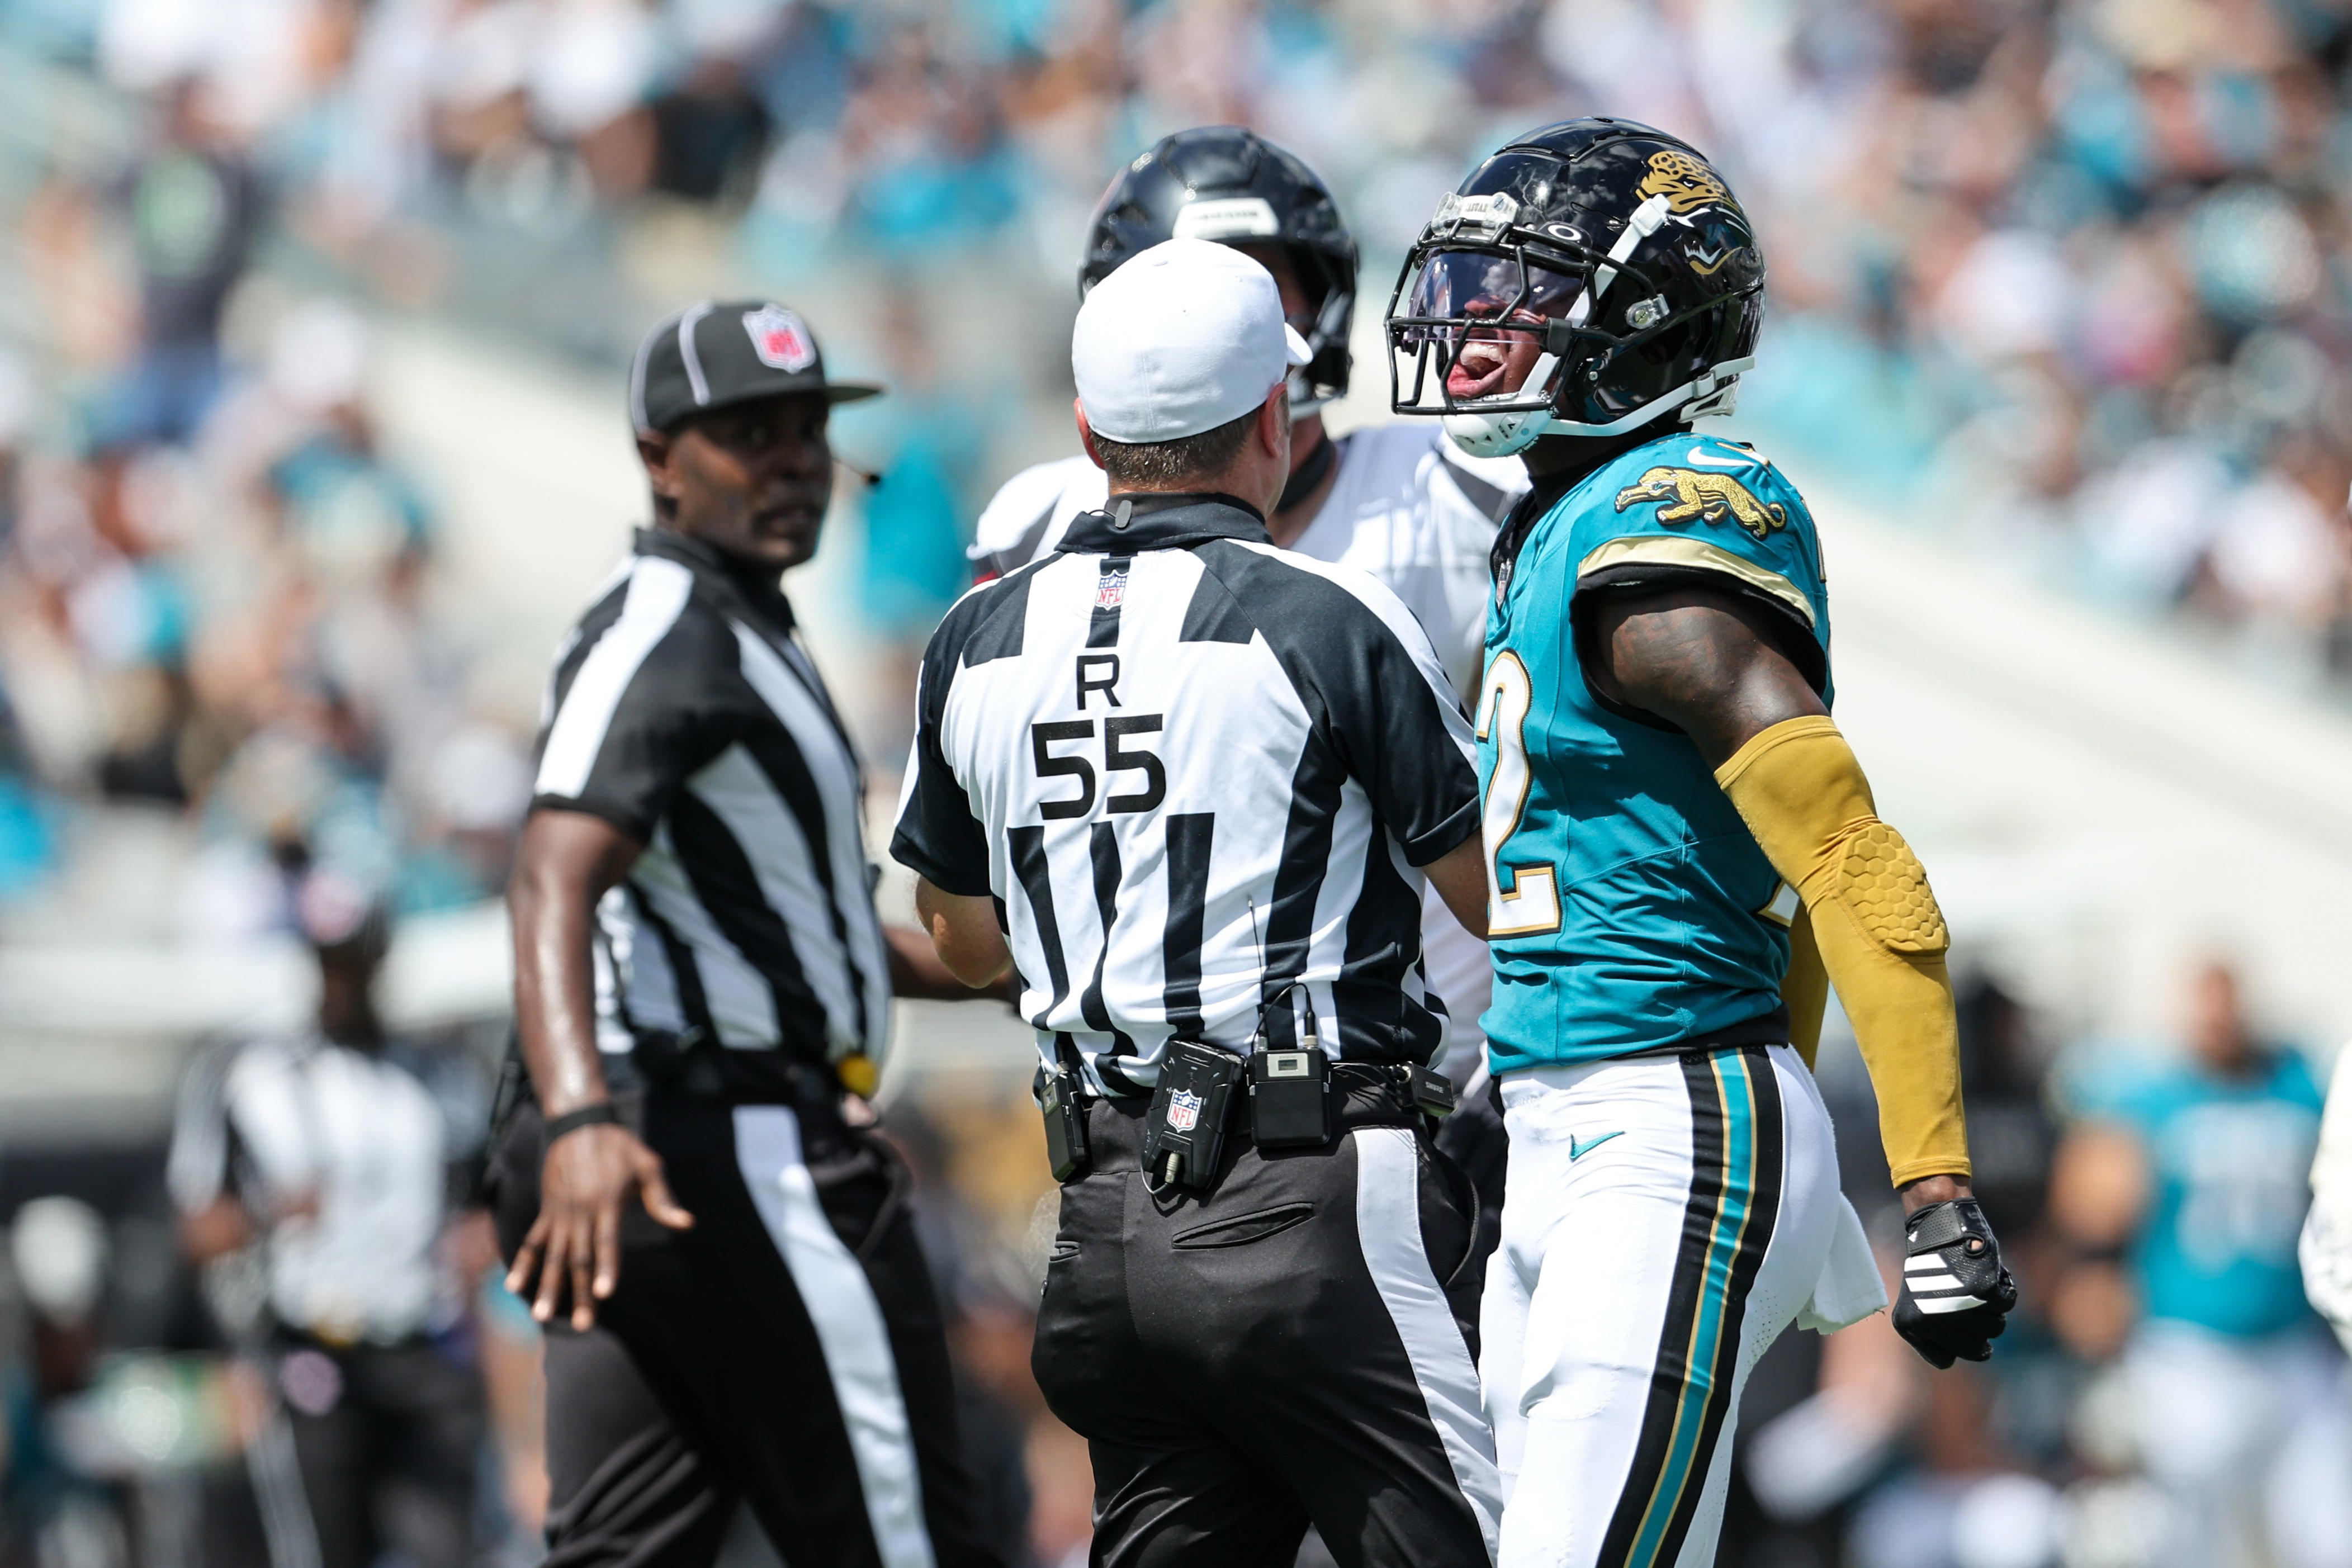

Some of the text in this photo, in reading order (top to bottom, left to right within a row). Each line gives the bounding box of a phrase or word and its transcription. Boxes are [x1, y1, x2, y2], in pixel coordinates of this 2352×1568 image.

[1097, 587, 1121, 604] NFL
[1076, 653, 1122, 710] R
[1031, 713, 1166, 821] 55
[1171, 1105, 1192, 1126] NFL
